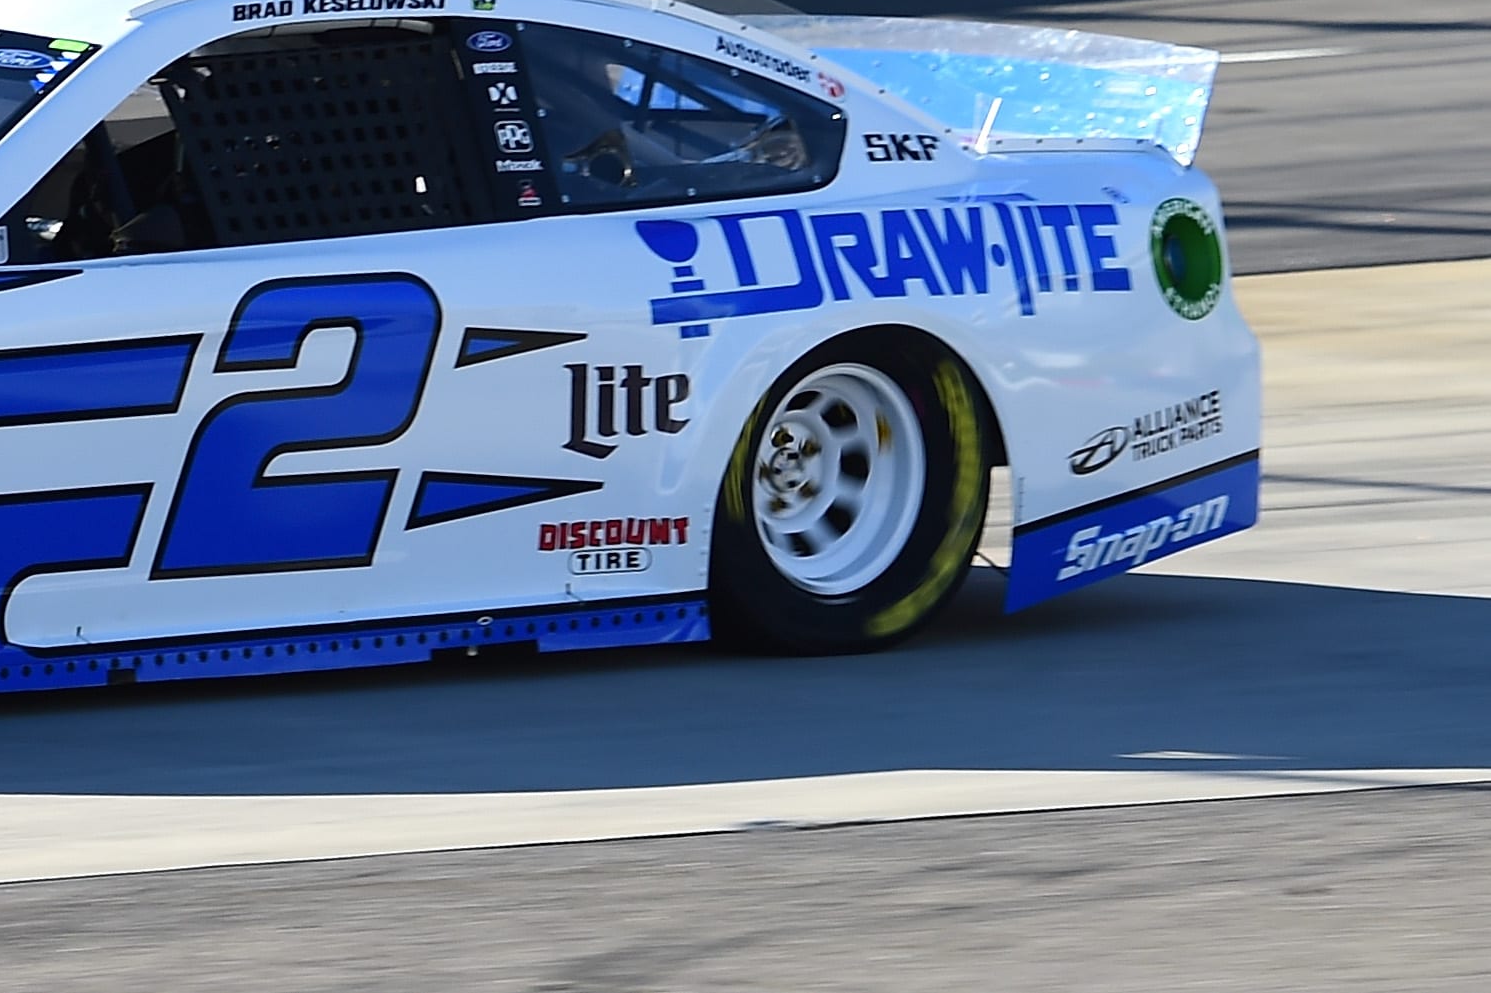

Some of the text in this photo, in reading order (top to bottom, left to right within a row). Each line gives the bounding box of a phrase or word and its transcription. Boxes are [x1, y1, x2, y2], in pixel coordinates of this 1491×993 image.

[233, 0, 293, 21] BRAD
[497, 125, 531, 148] PPG
[862, 133, 940, 161] SKF
[149, 272, 442, 580] 2
[562, 363, 691, 459] Lite
[1133, 389, 1220, 437] ALLIANCE
[1131, 433, 1178, 461] TRUCK
[538, 517, 689, 551] DISCOUNT
[1056, 494, 1230, 581] Snap-on
[576, 551, 641, 571] TIRE
